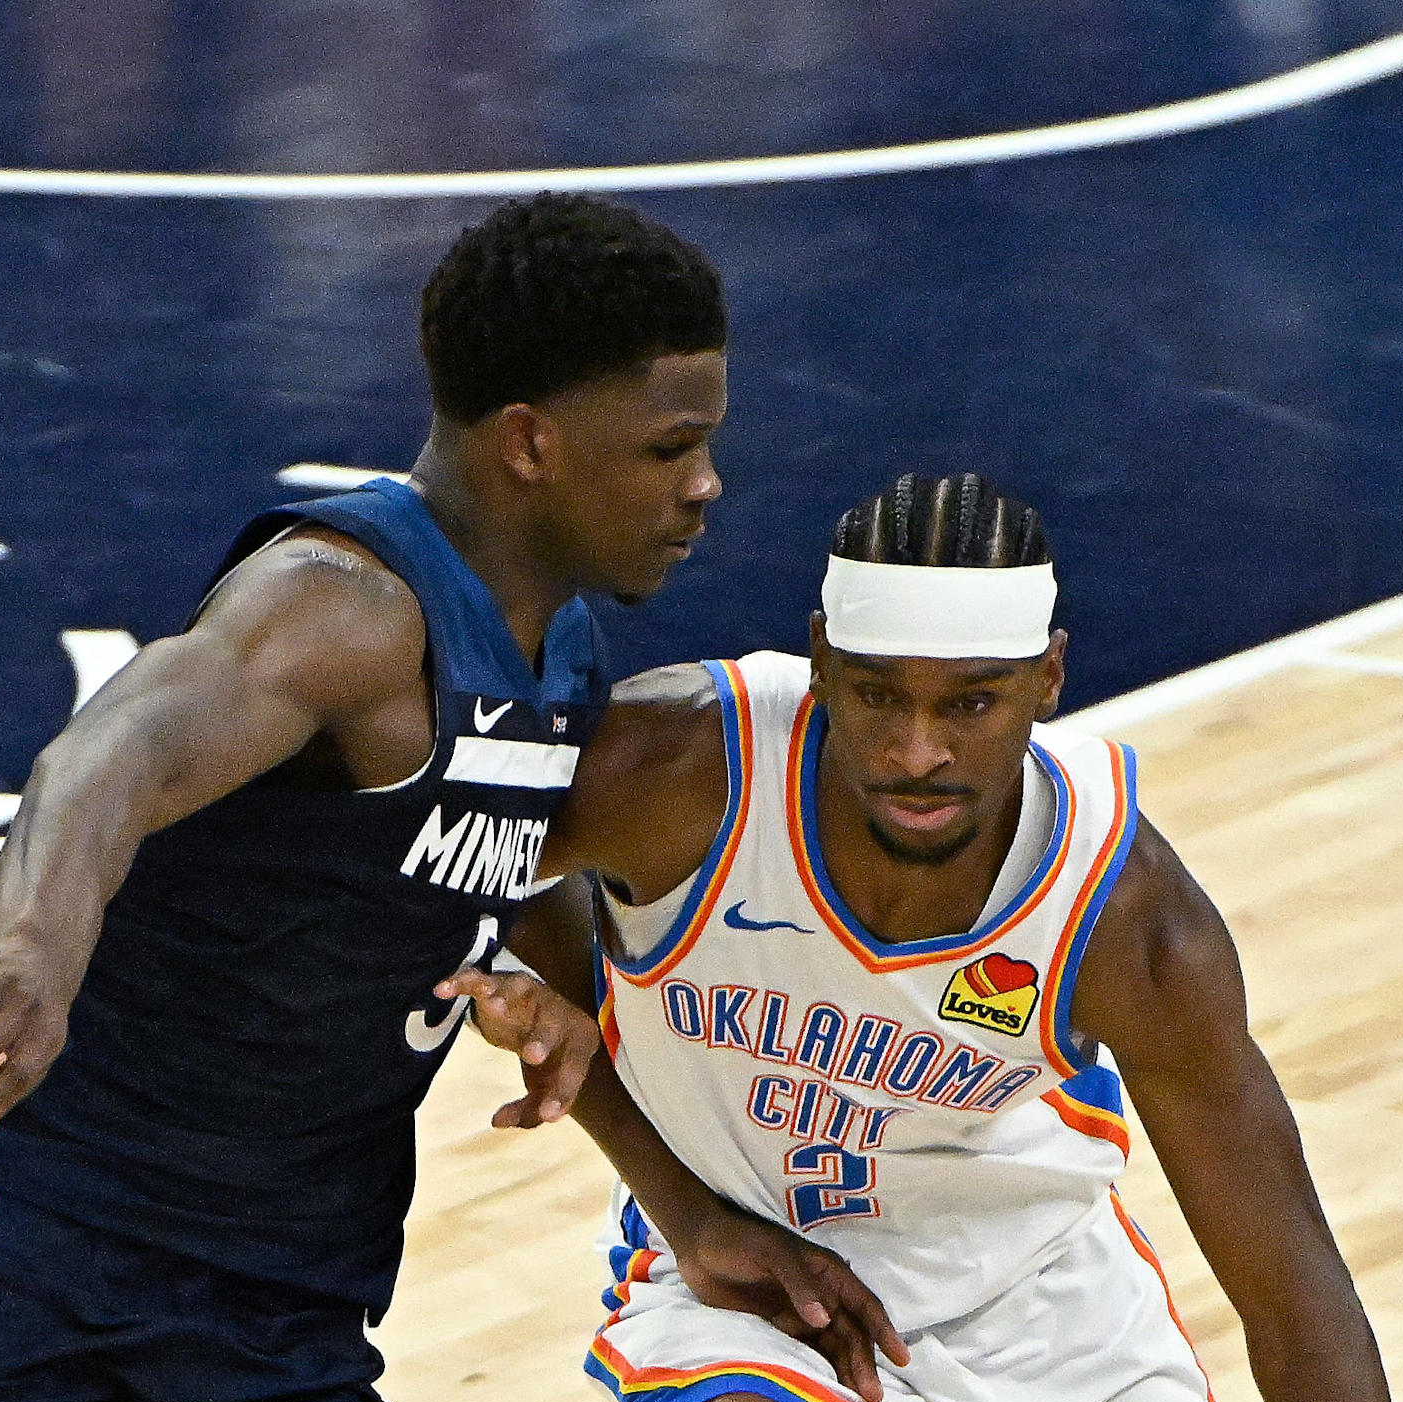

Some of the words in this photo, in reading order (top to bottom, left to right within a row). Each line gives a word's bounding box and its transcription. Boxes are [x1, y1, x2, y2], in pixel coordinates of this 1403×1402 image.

[400, 803, 550, 902] MINNES
[660, 979, 1041, 1113] OKLAHOMA
[784, 1142, 881, 1232] 2
